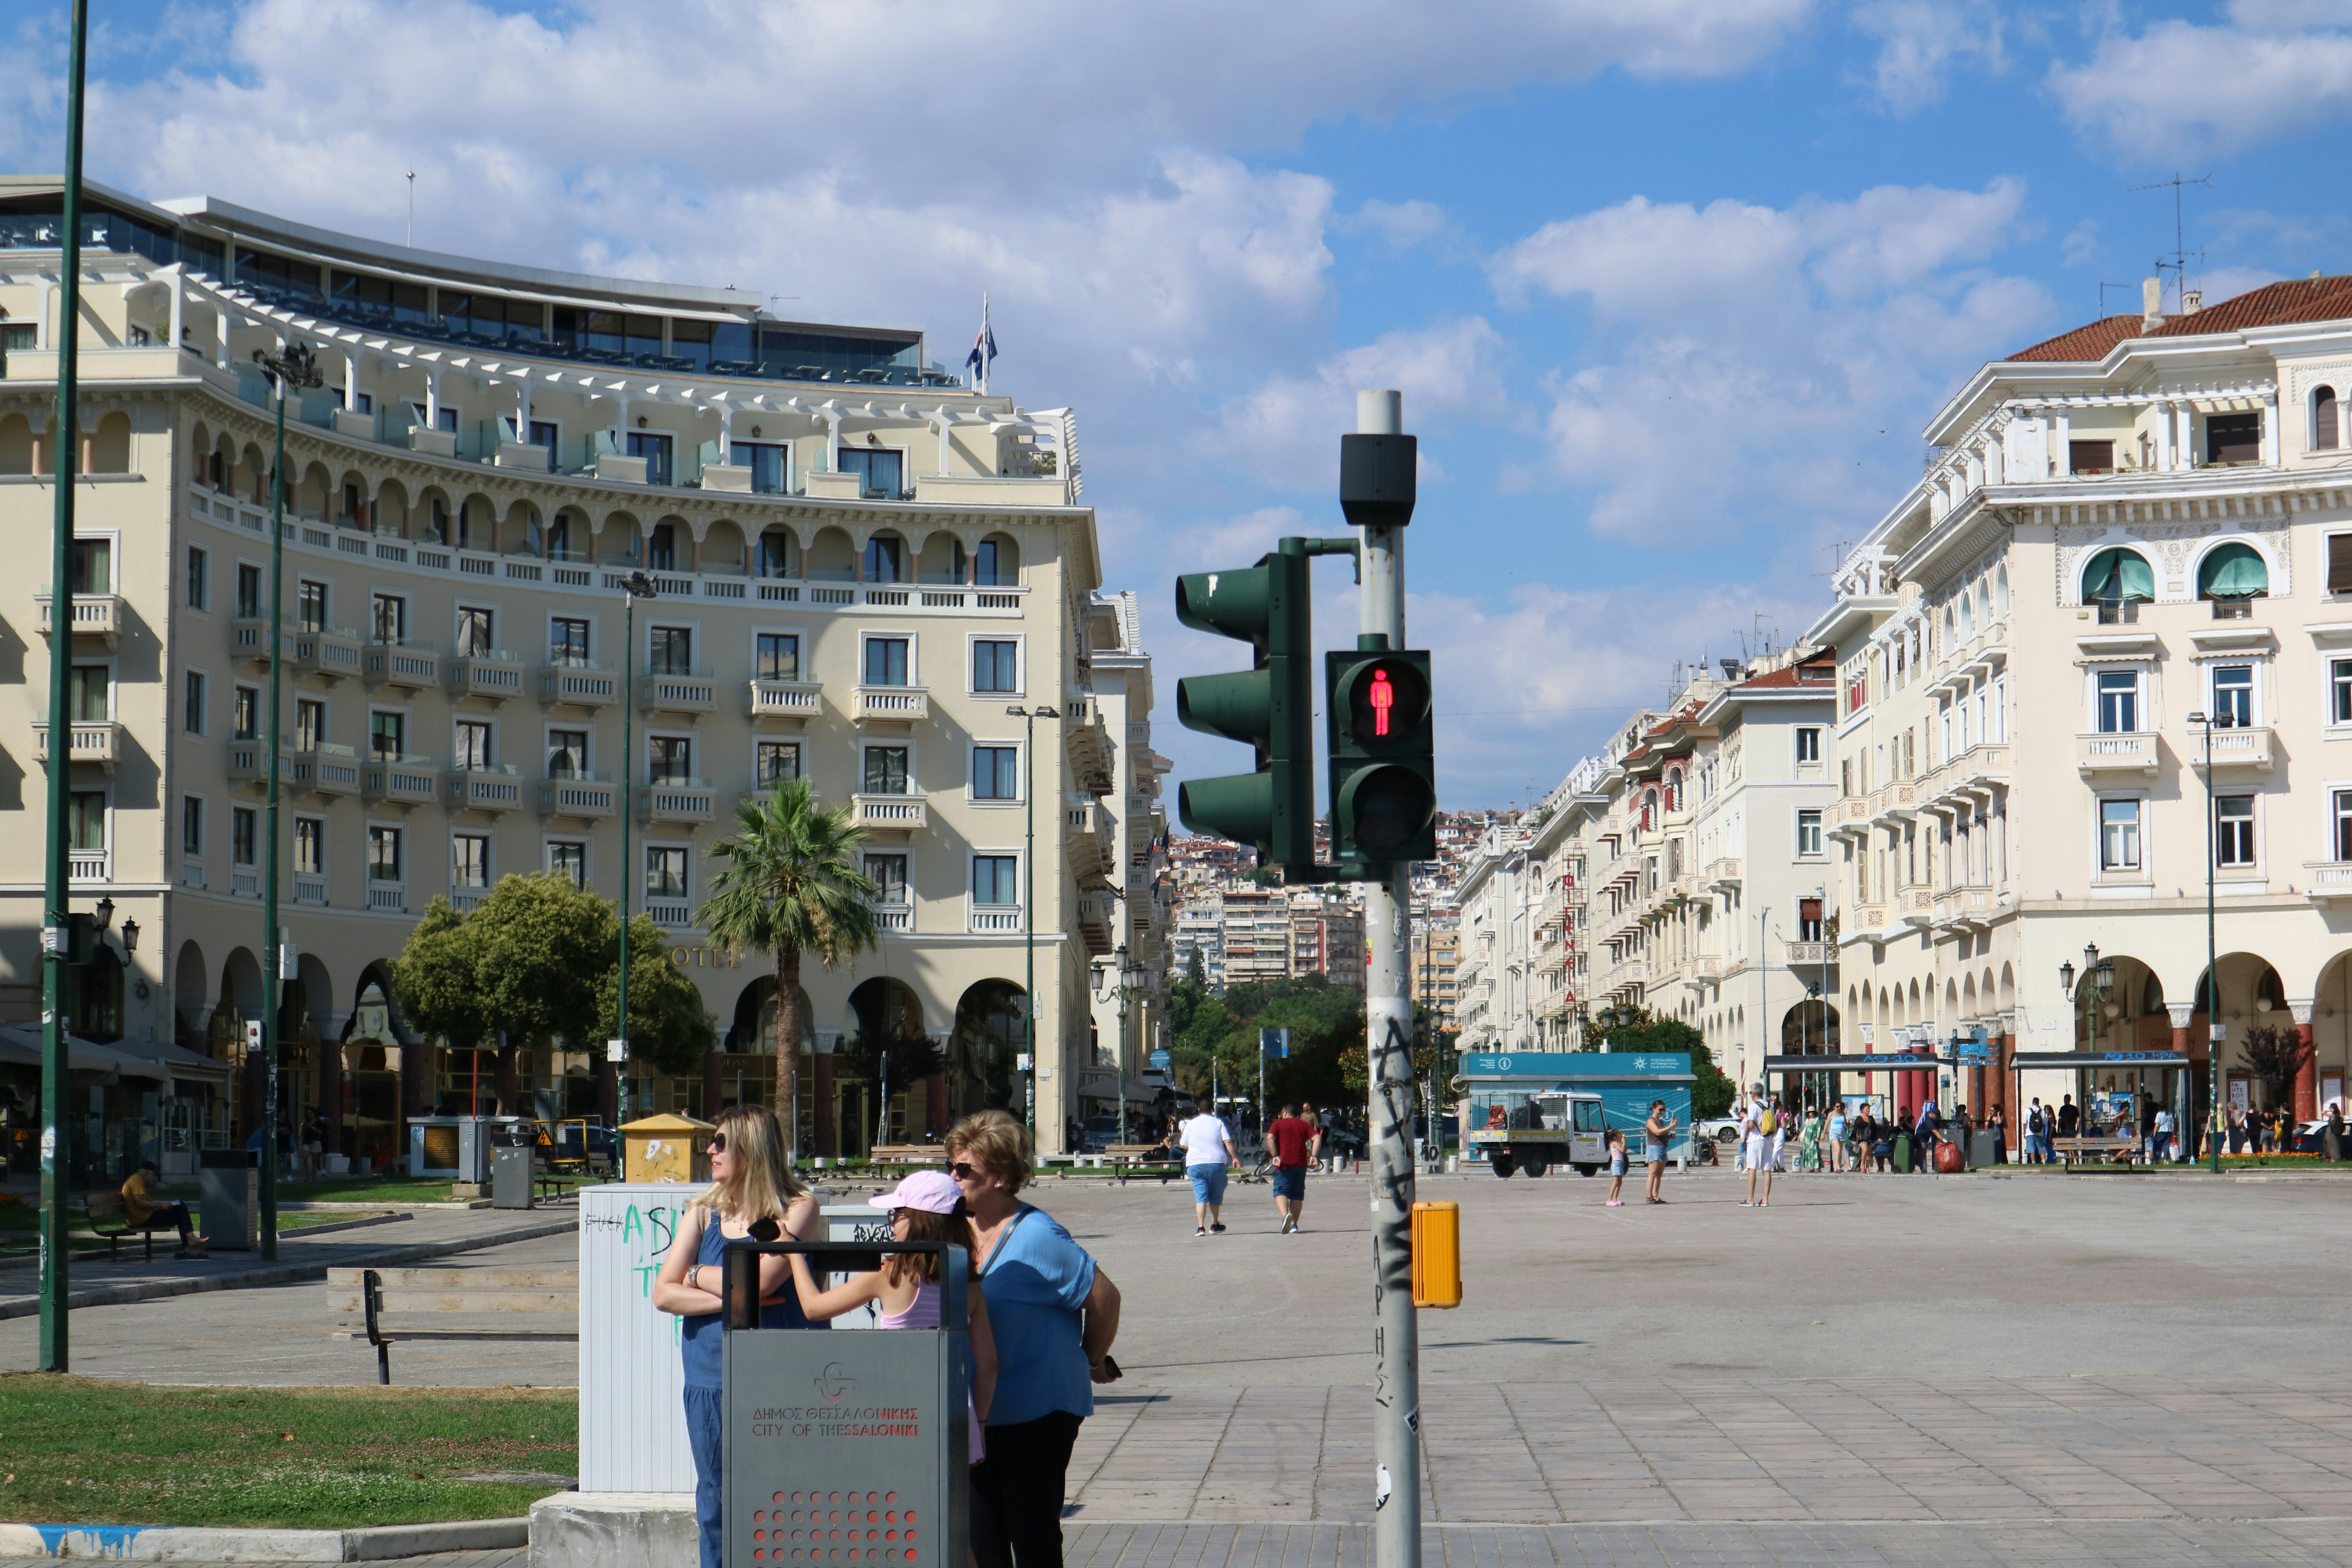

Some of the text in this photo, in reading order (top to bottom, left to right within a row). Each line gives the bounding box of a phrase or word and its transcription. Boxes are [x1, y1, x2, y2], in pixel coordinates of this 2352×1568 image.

[671, 947, 742, 967] OTEL
[1891, 1054, 1918, 1063] 10
[753, 1408, 918, 1420] ΔΗΜΟΣ ΘΕΣΣΑΛΟΝΙΚΗΣ
[753, 1424, 918, 1437] CITY OF THESSALONIKI
